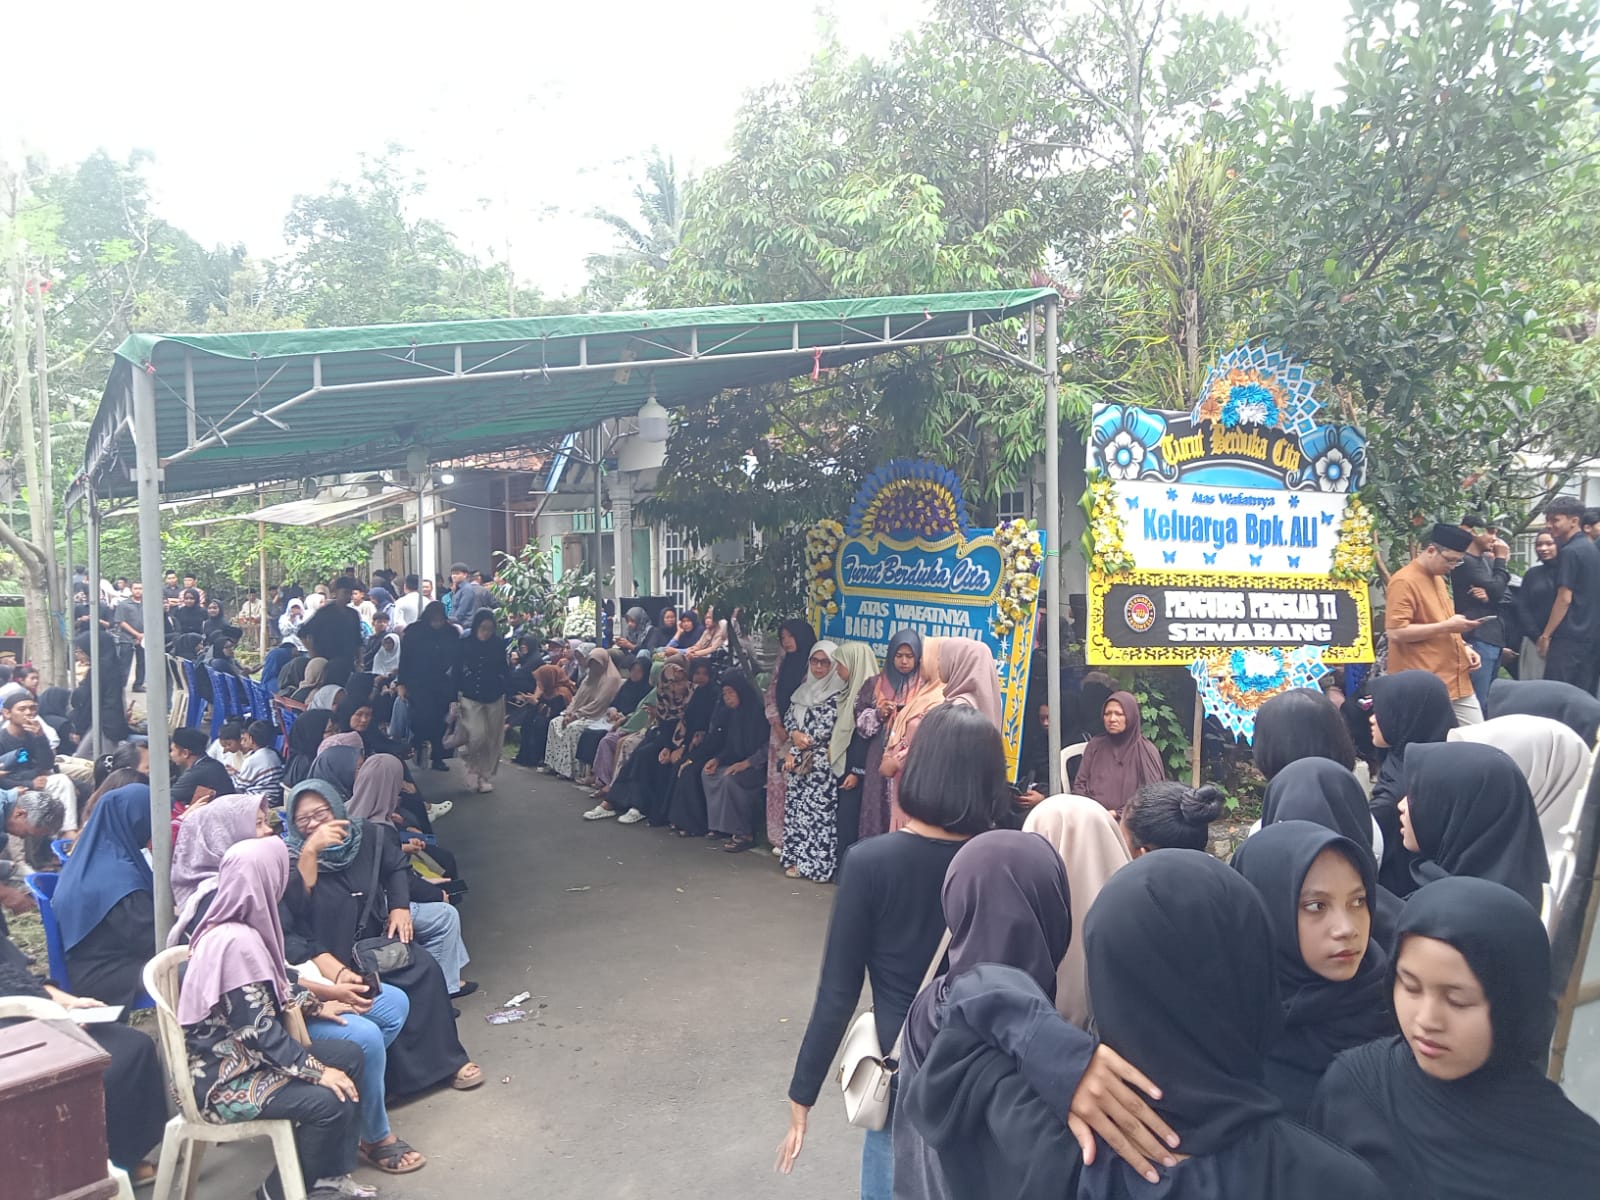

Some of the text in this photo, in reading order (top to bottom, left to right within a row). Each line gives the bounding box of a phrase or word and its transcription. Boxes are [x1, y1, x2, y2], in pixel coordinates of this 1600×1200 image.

[1160, 424, 1300, 471] Turut Berduka Cita
[1192, 491, 1276, 510] Atas Wafatnya
[1143, 508, 1238, 549] Keluarga
[844, 554, 991, 593] Turut Berduka Cita
[858, 601, 971, 627] ATAS WAFATNYA
[1319, 594, 1338, 620] TI
[845, 615, 884, 639] BAGAS
[1168, 623, 1332, 642] SEMARANG
